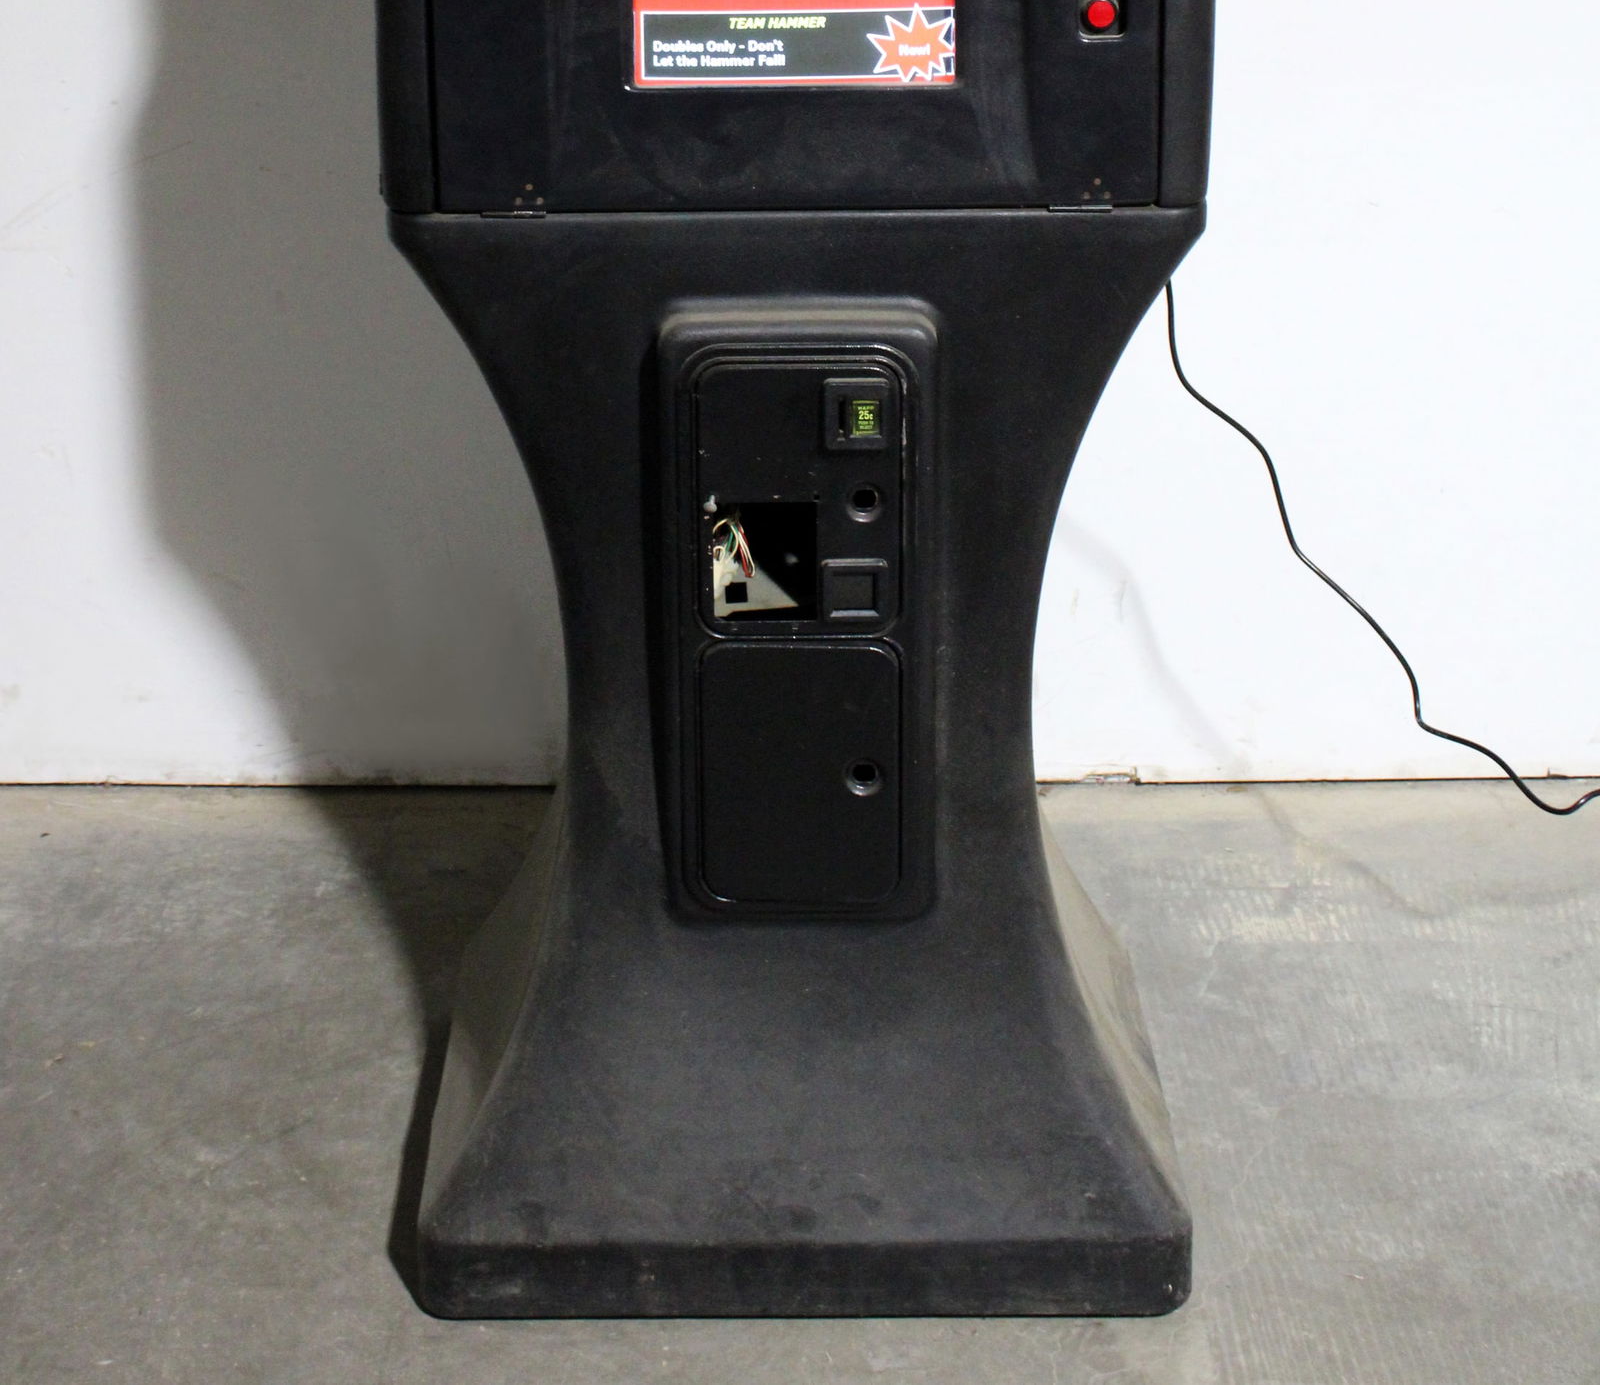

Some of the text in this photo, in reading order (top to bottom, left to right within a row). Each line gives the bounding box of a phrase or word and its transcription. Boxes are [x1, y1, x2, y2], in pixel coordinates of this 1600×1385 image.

[729, 16, 826, 30] TEAM HAMMER
[652, 39, 704, 53] Doubles
[706, 39, 736, 55] Only
[747, 38, 784, 52] Don't
[652, 55, 674, 67] Let
[675, 55, 698, 67] the
[700, 55, 756, 67] Hammer
